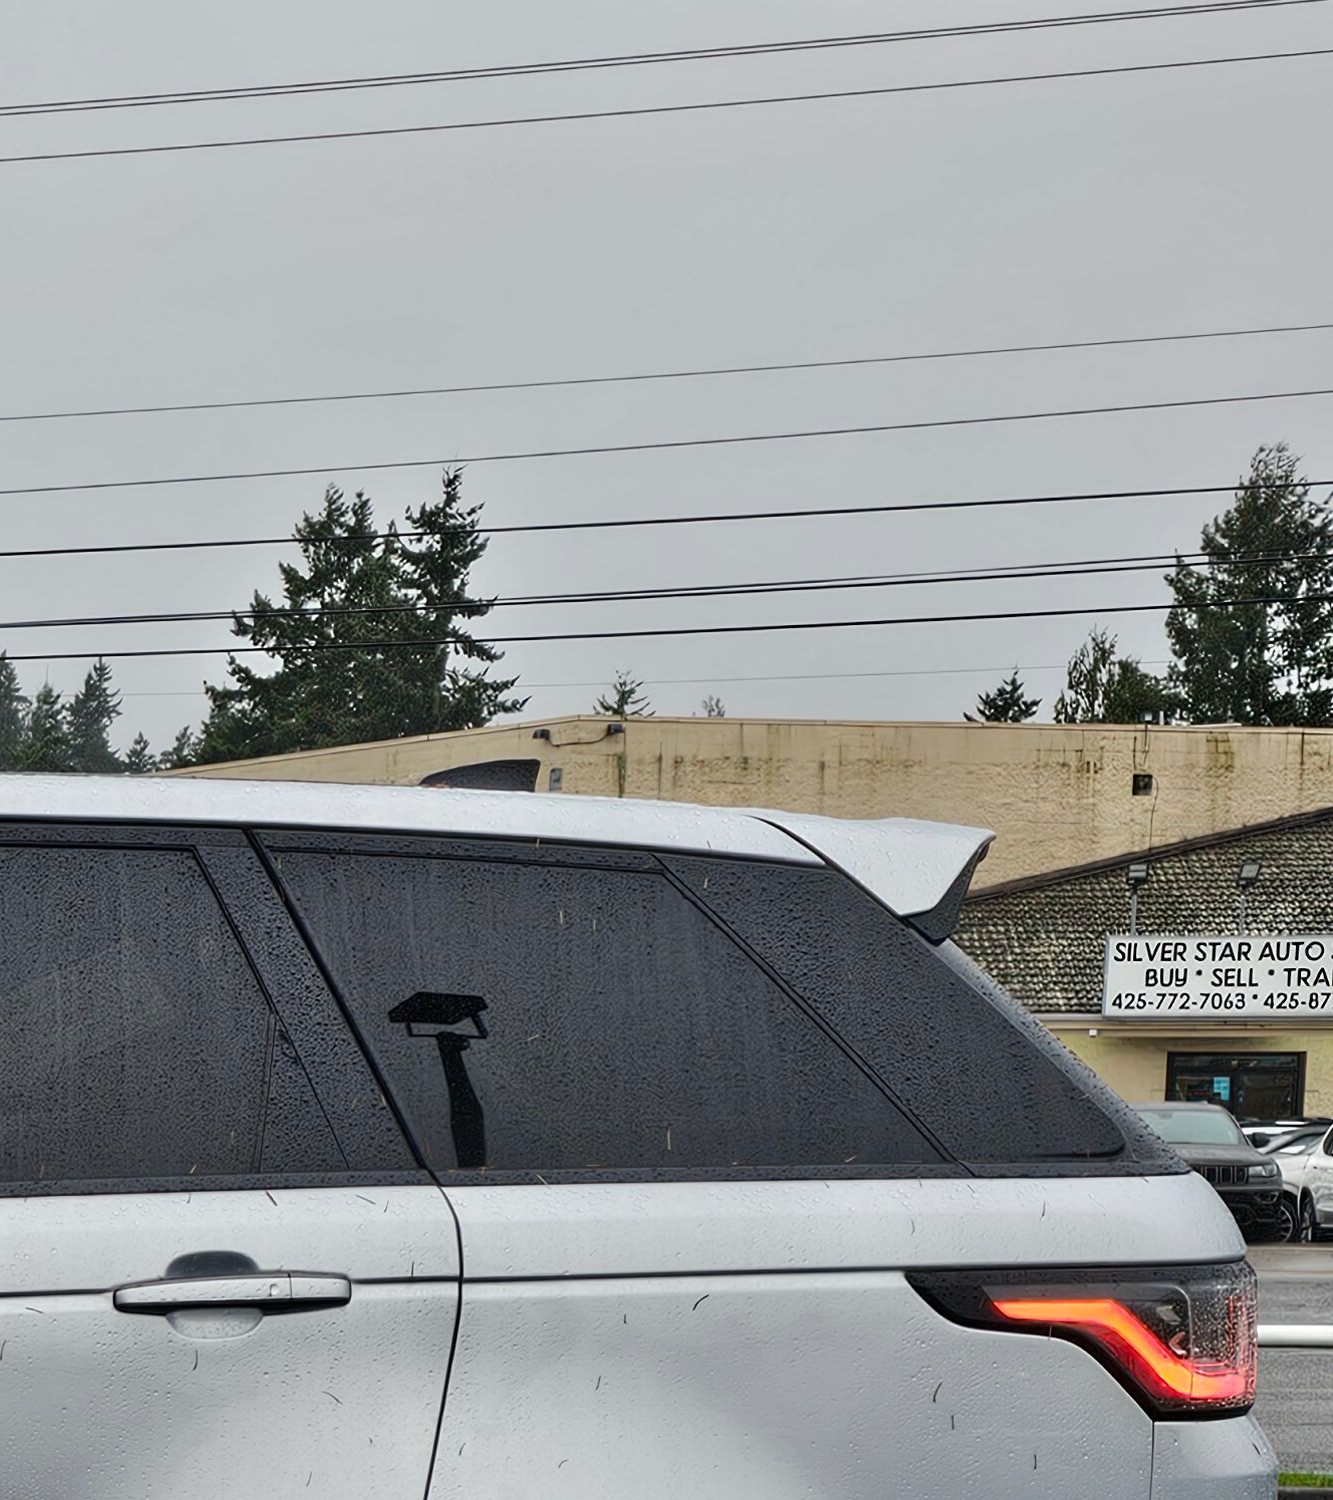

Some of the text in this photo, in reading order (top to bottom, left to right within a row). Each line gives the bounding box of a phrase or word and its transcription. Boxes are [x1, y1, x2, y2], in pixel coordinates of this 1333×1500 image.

[1113, 941, 1325, 962] SILVER STAR AUTO
[1144, 967, 1333, 988] BUY SELL TRA
[1111, 993, 1333, 1010] 425-772-7063 425-87
